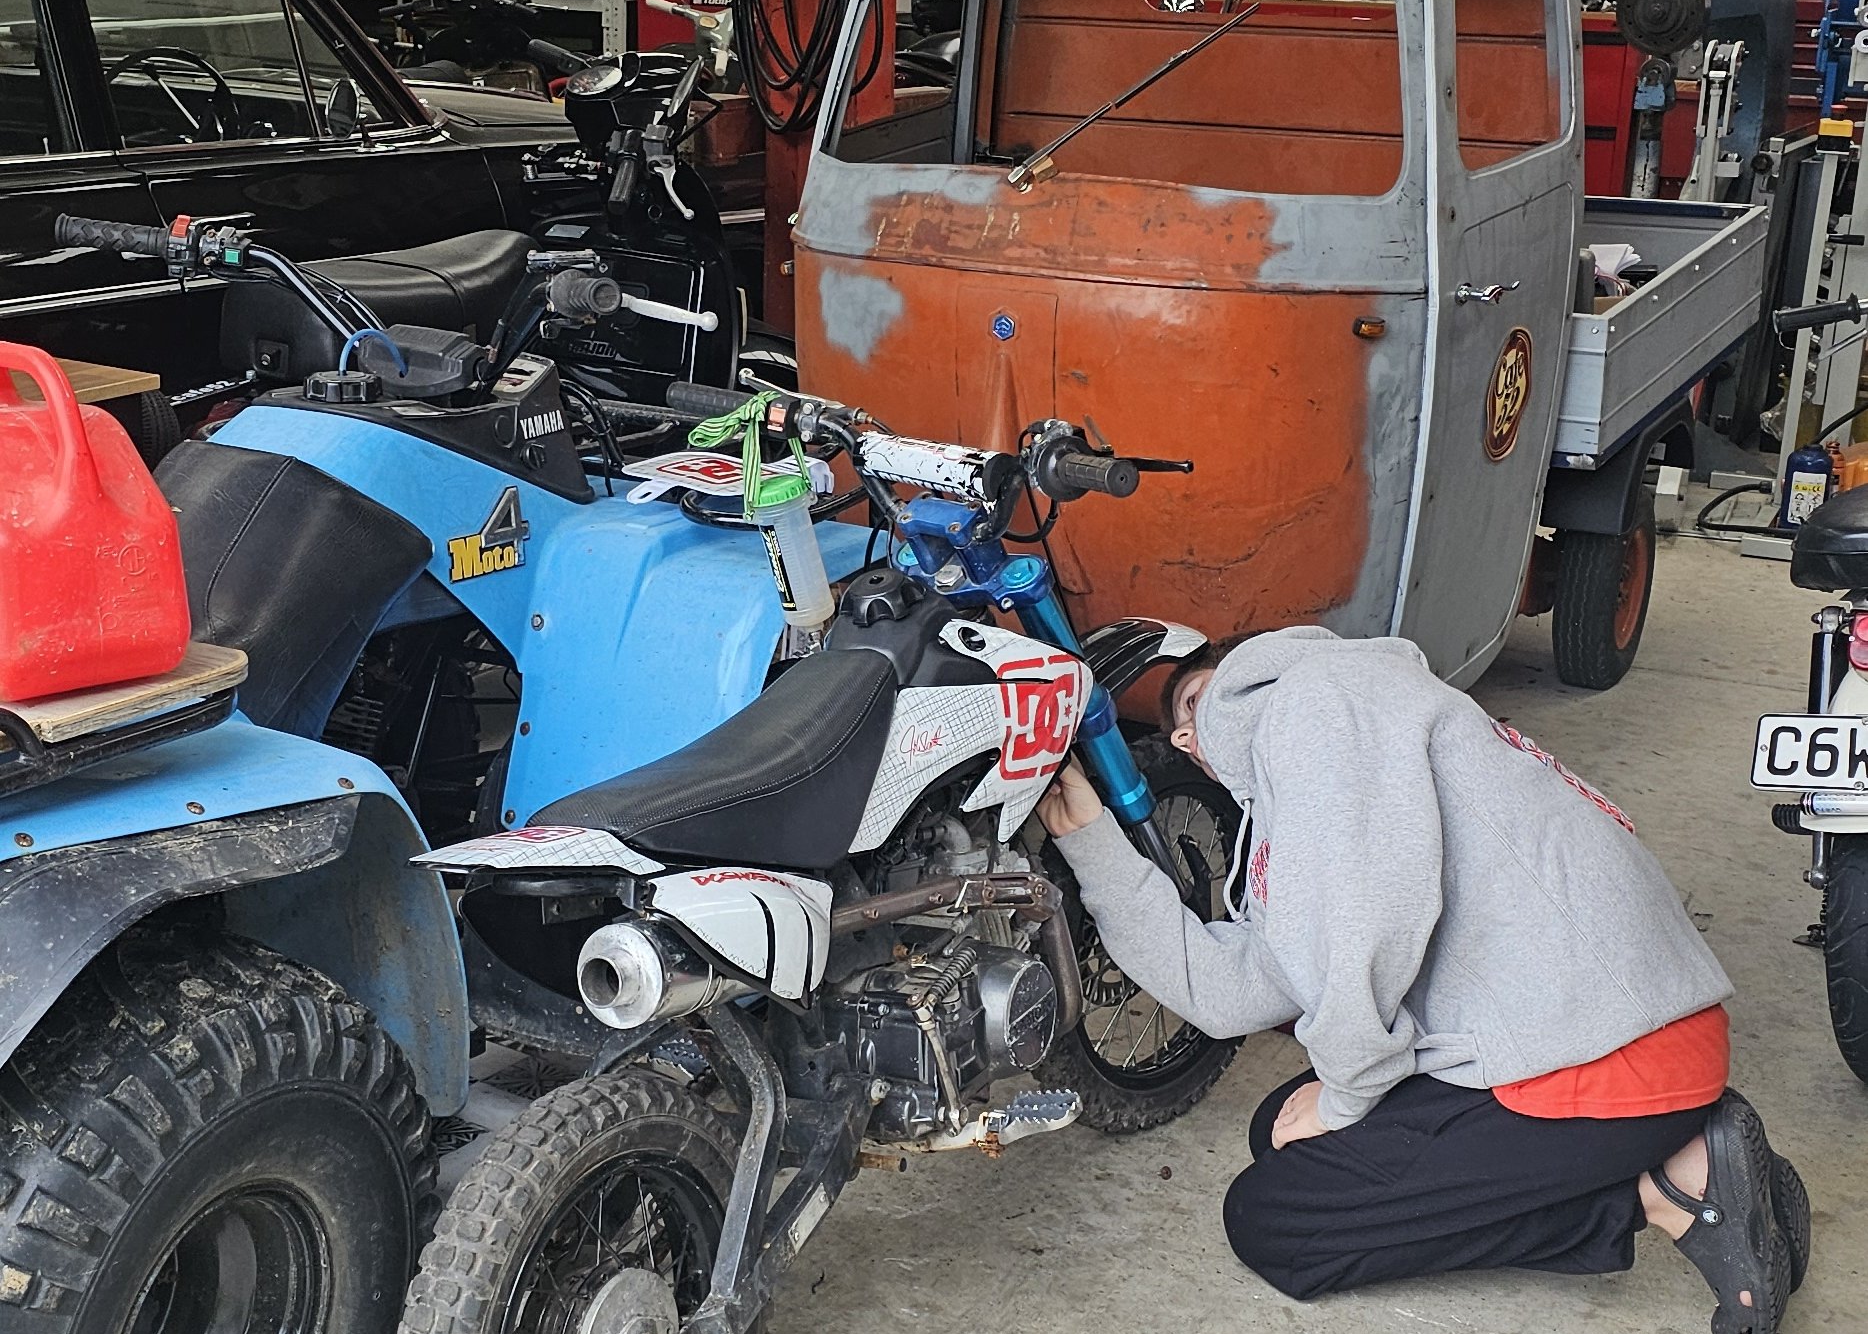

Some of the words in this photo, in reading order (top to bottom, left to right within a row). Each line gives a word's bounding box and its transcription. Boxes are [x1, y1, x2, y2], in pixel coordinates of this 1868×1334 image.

[520, 410, 564, 439] YAMAHA
[1496, 385, 1521, 431] 52
[481, 486, 530, 566] 4
[449, 534, 516, 581] Moto
[1011, 673, 1075, 761] DC
